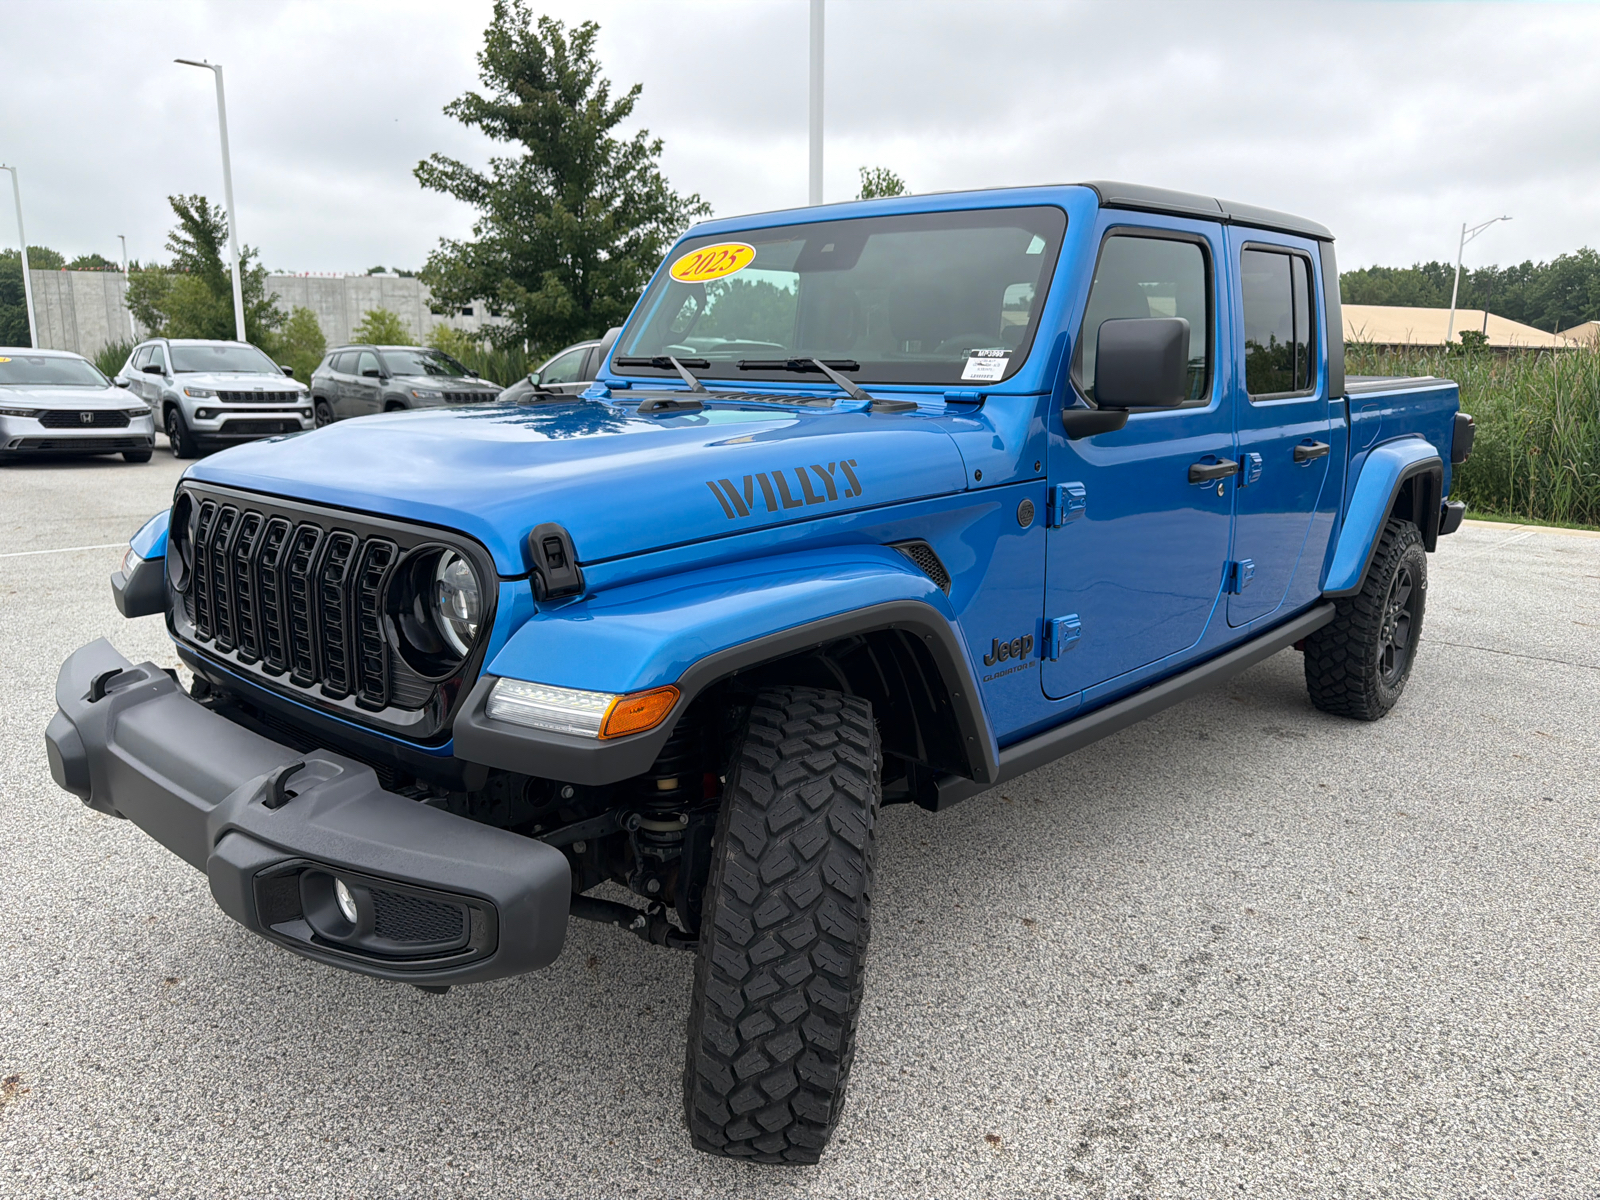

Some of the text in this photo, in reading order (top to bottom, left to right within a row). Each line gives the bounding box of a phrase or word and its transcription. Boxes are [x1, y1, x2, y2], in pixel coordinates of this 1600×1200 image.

[679, 247, 746, 277] 2025
[706, 459, 863, 520] WILLYS
[983, 633, 1034, 667] Jeep
[983, 663, 1028, 682] GLADIATOR
